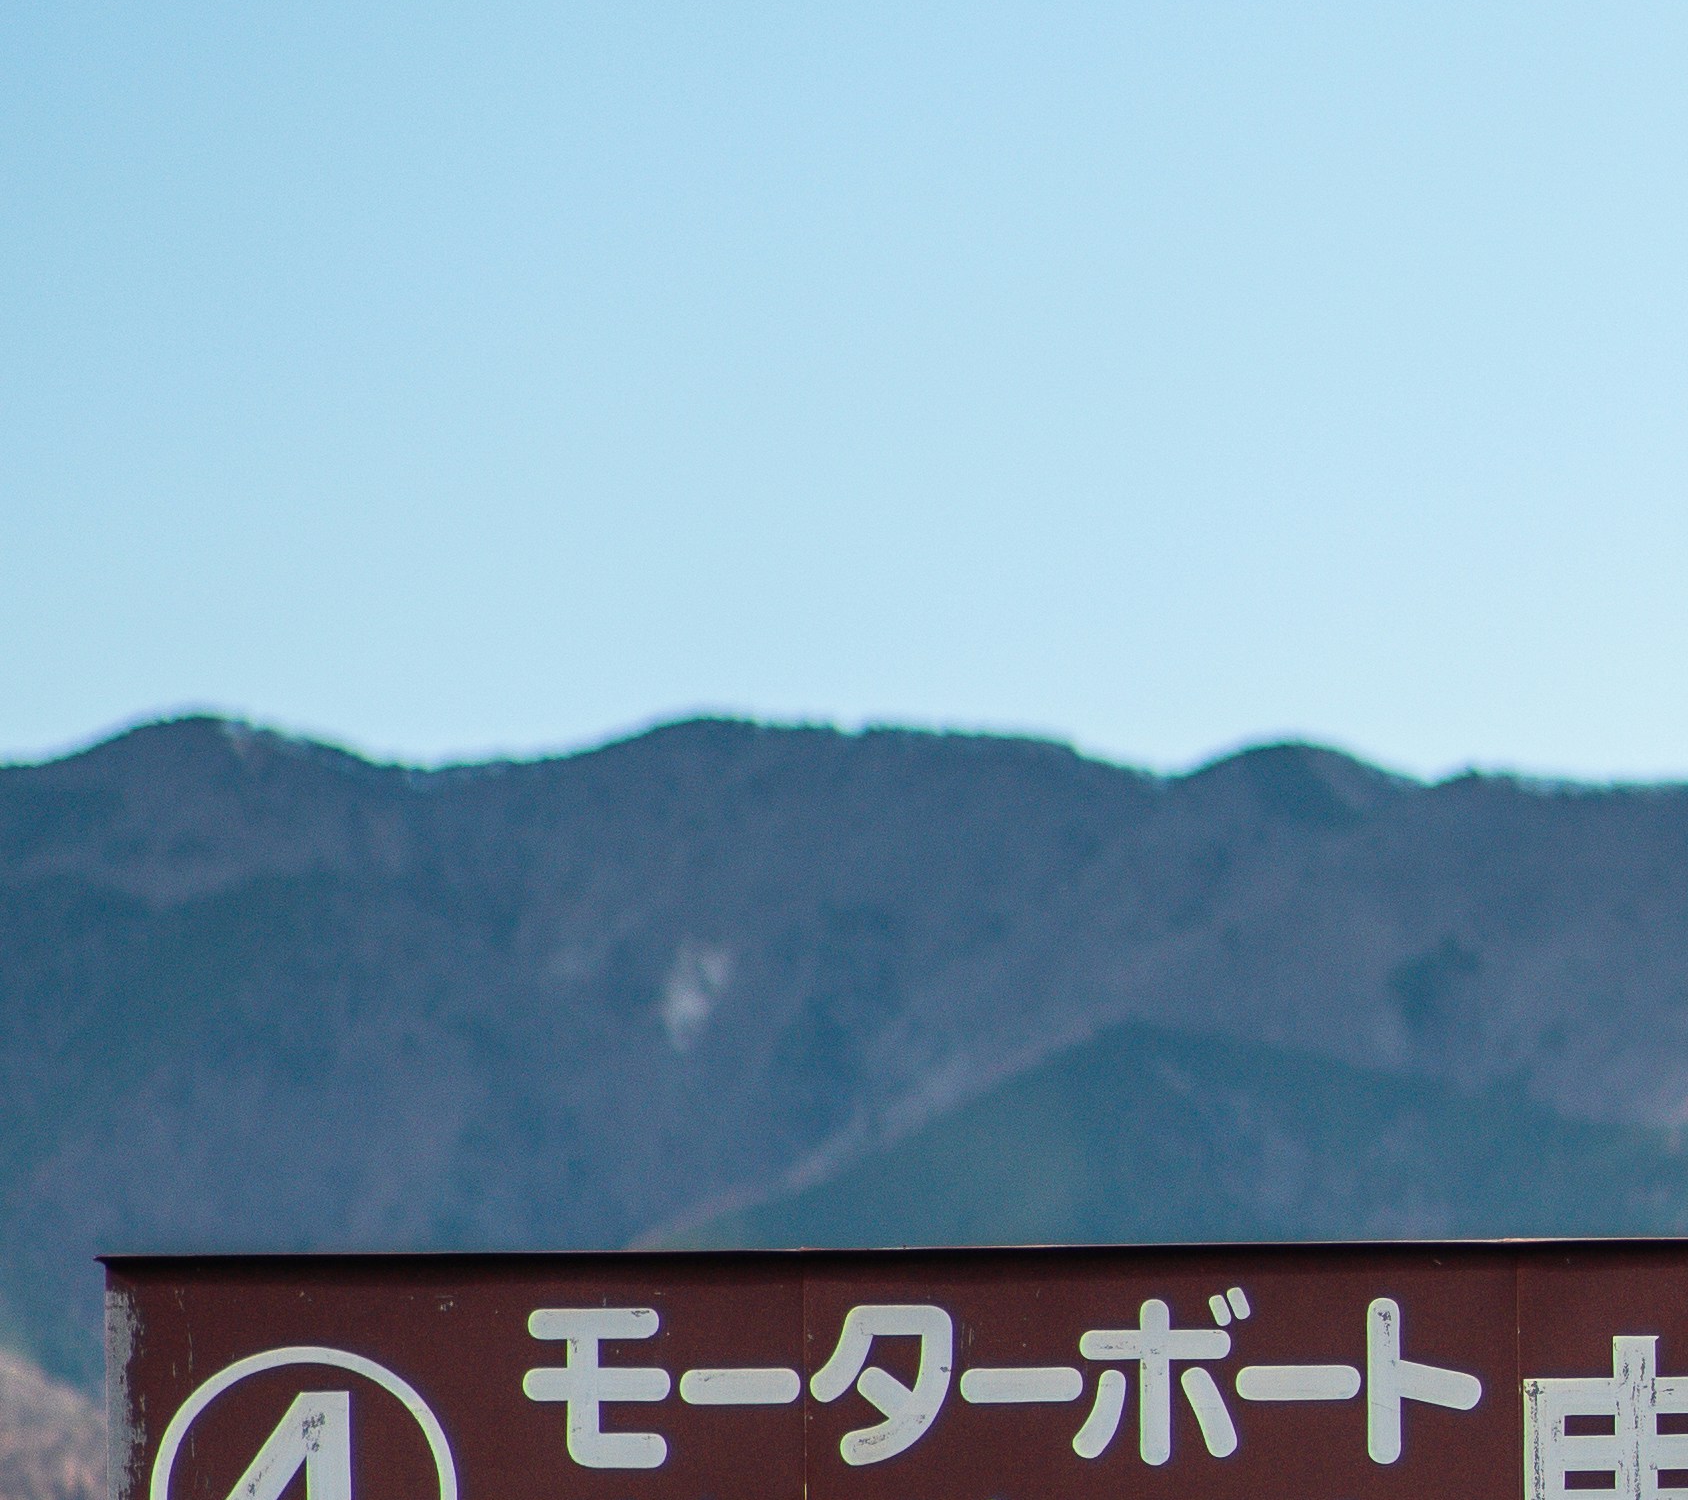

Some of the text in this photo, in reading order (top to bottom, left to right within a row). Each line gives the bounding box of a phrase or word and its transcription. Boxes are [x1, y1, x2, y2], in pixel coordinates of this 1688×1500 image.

[523, 1286, 1483, 1470] モーターボート
